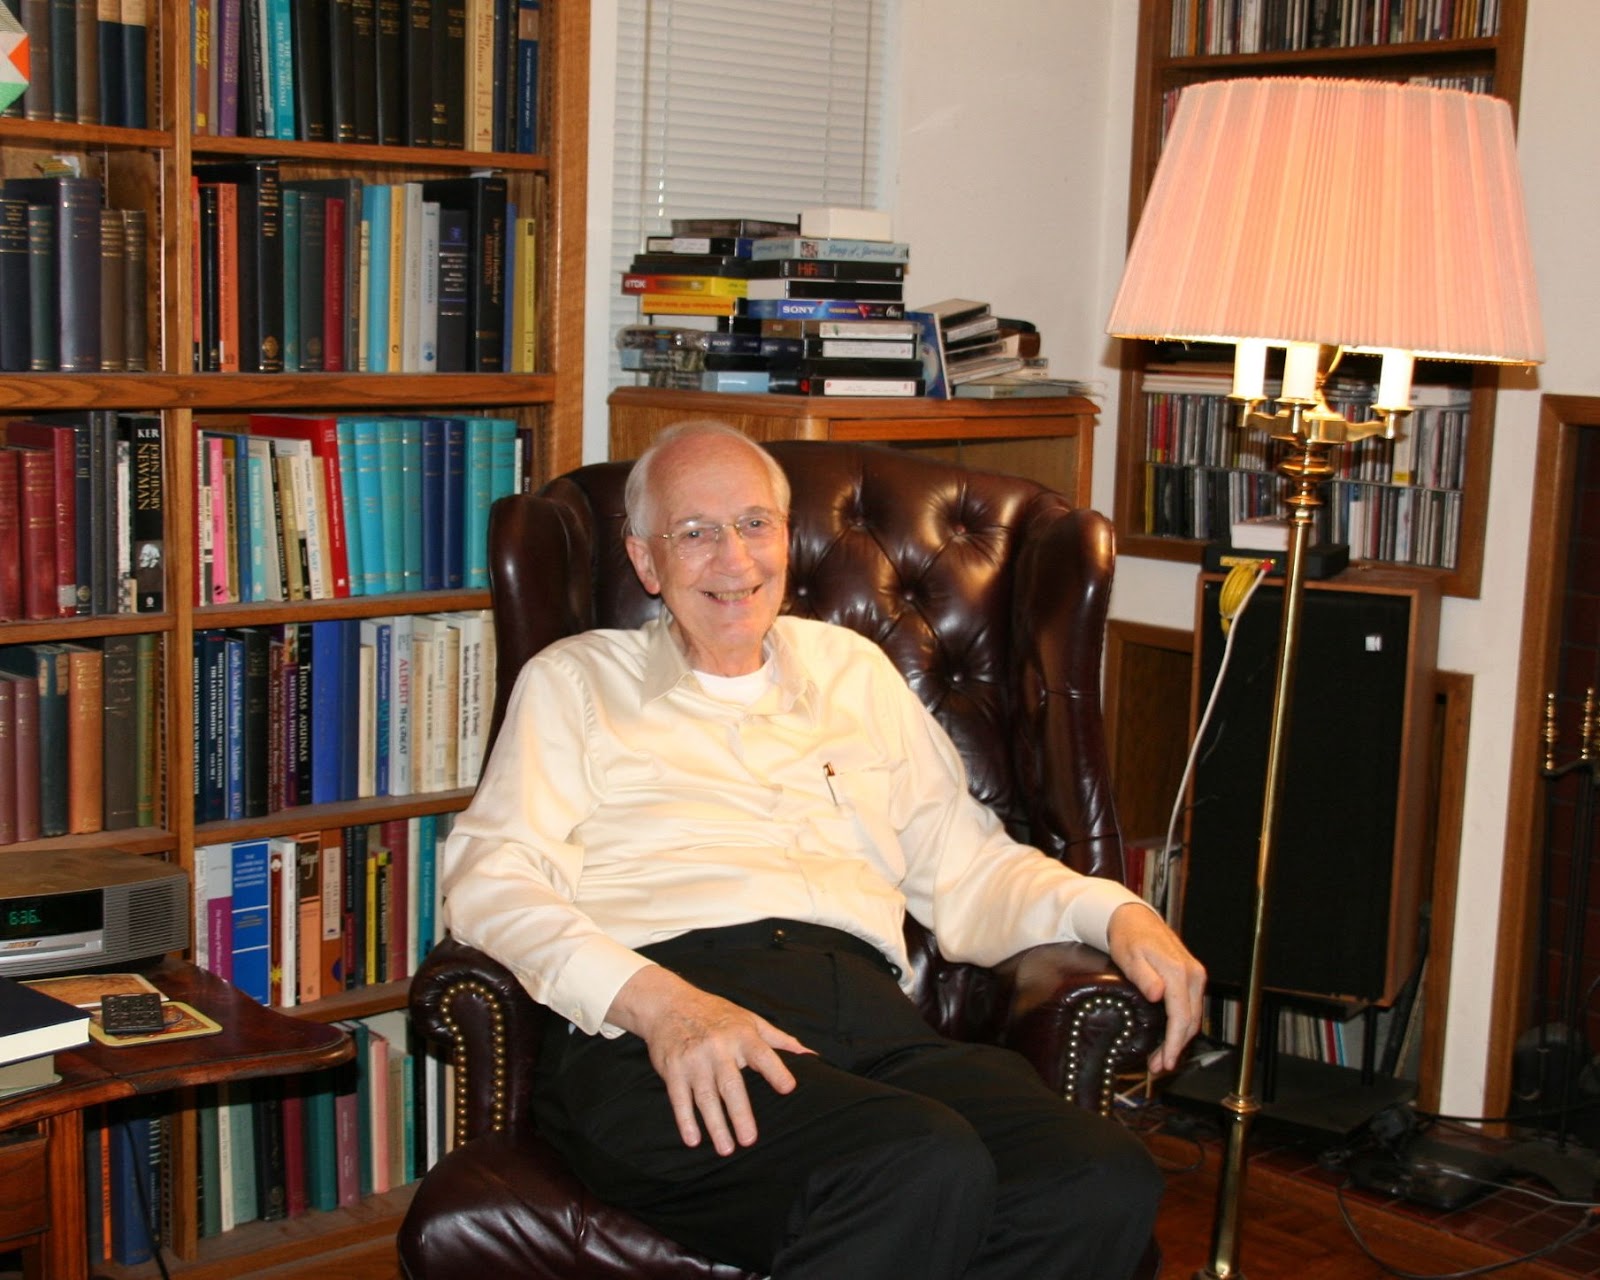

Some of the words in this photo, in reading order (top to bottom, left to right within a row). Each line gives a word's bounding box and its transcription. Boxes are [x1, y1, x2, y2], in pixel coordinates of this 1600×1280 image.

[279, 69, 287, 106] ABROAD
[628, 279, 646, 289] TDK
[782, 305, 816, 314] SONY
[137, 428, 160, 438] KER
[150, 443, 160, 472] JOHN
[137, 443, 150, 510] NEWMAN
[151, 475, 160, 510] HENRY
[274, 491, 282, 515] POETRY
[307, 510, 318, 537] Poetics
[309, 550, 320, 572] Space
[230, 650, 240, 667] Early
[232, 669, 240, 700] Medieval
[299, 663, 311, 709] THOMAS
[399, 658, 409, 705] ALBERT
[472, 674, 480, 705] Philosophy
[230, 701, 240, 738] Philosophy
[399, 707, 407, 723] THE
[472, 712, 480, 737] Theology
[299, 714, 309, 762] AQUINAS
[399, 726, 407, 755] GREAT
